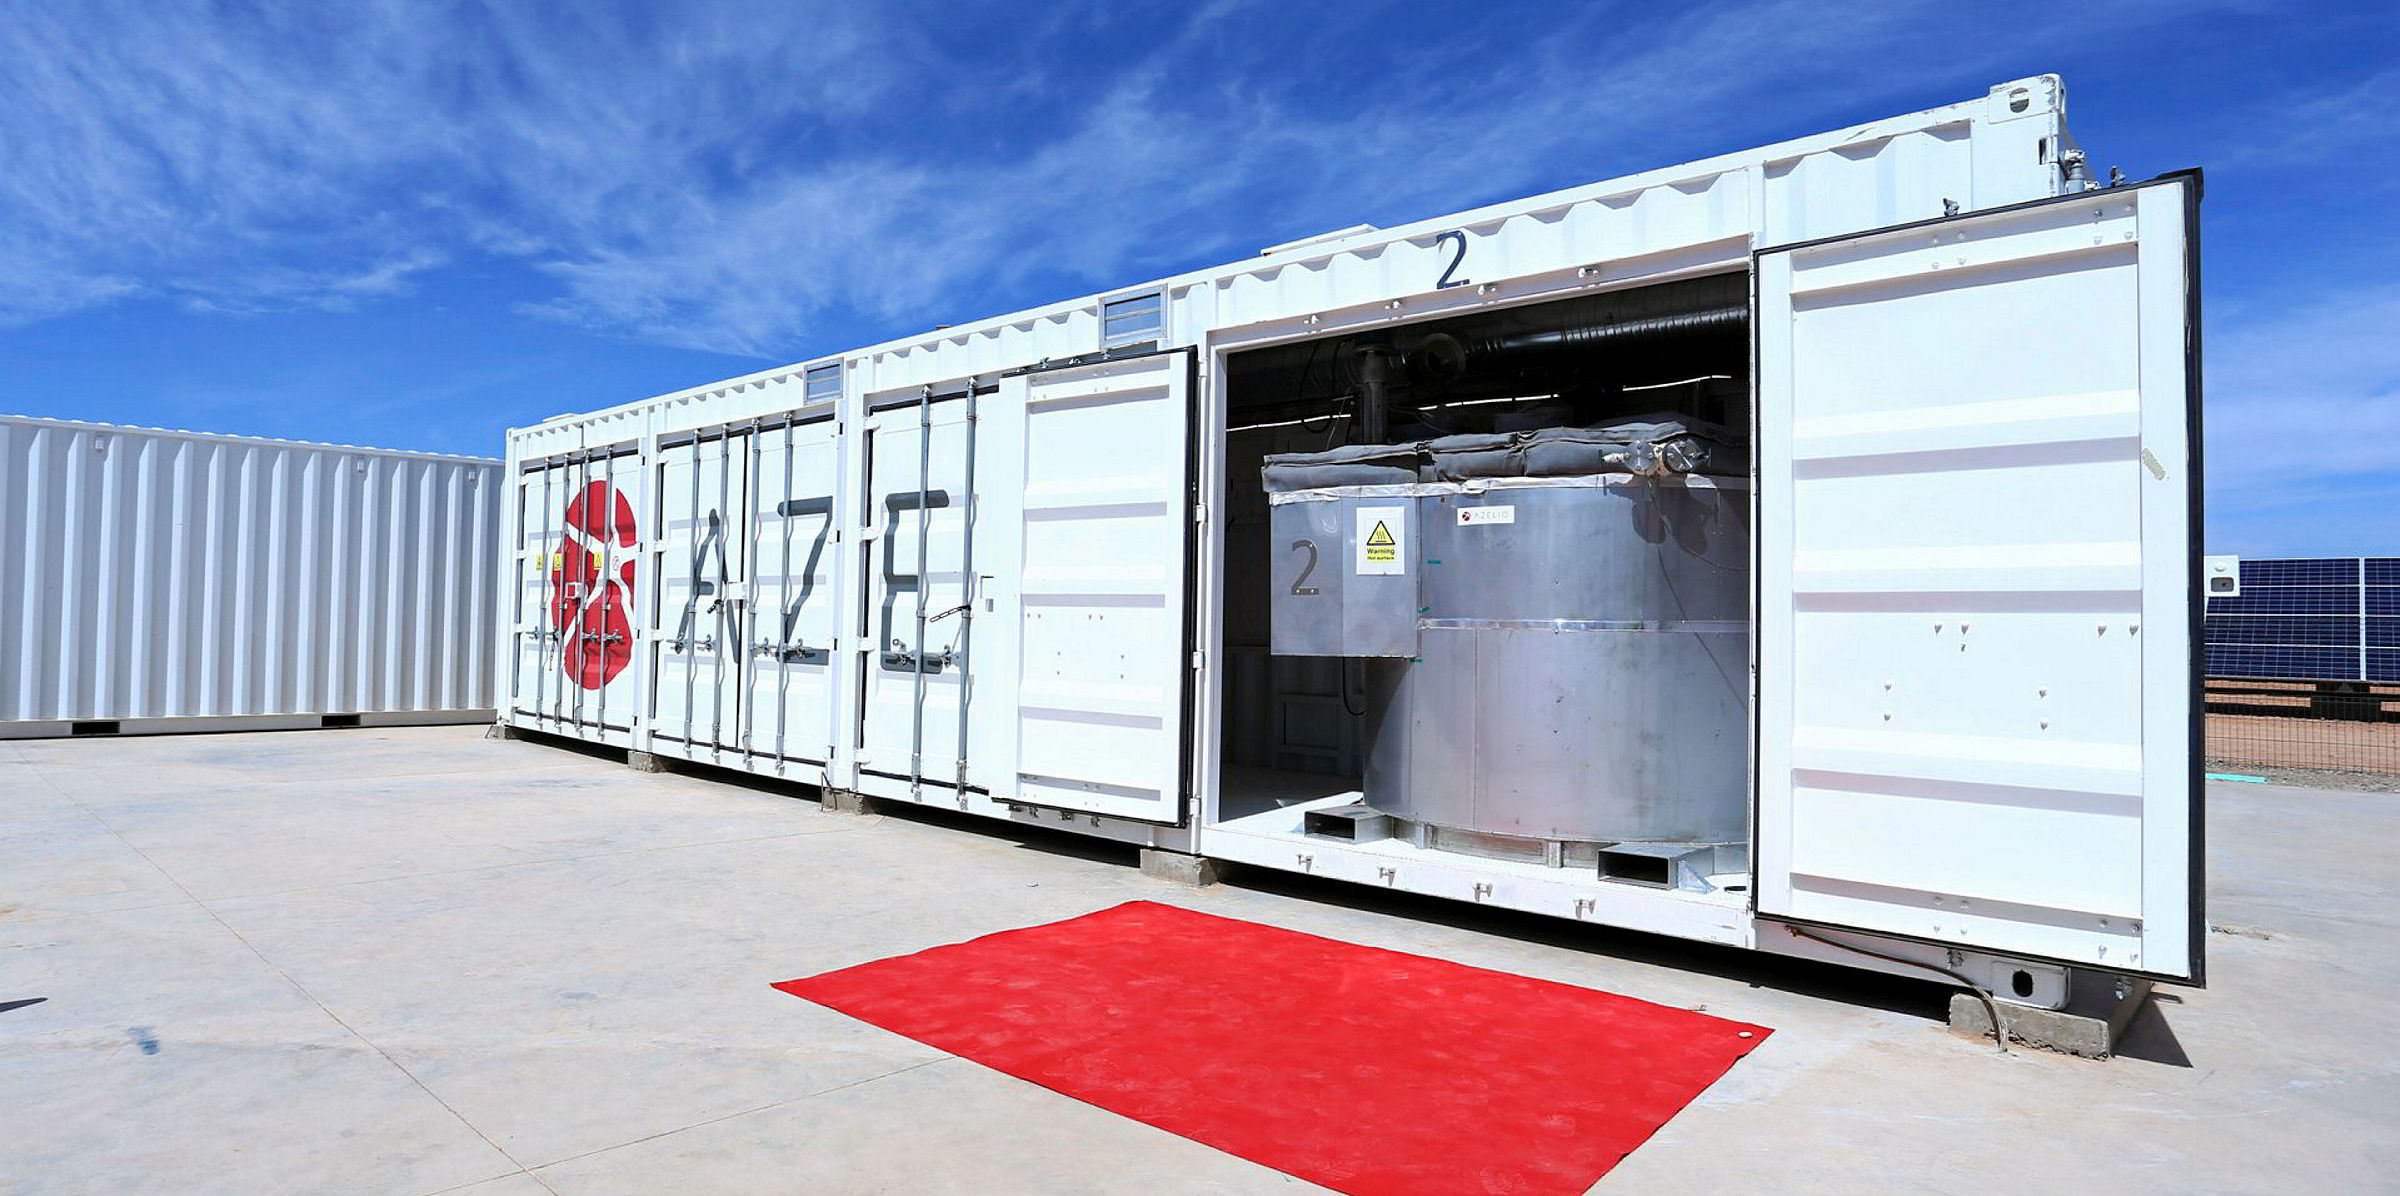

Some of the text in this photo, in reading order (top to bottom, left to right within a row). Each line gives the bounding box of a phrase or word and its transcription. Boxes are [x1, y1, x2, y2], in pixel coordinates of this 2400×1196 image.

[1436, 230, 1470, 289] 2
[1290, 539, 1320, 595] 2
[1367, 548, 1395, 556] Warning
